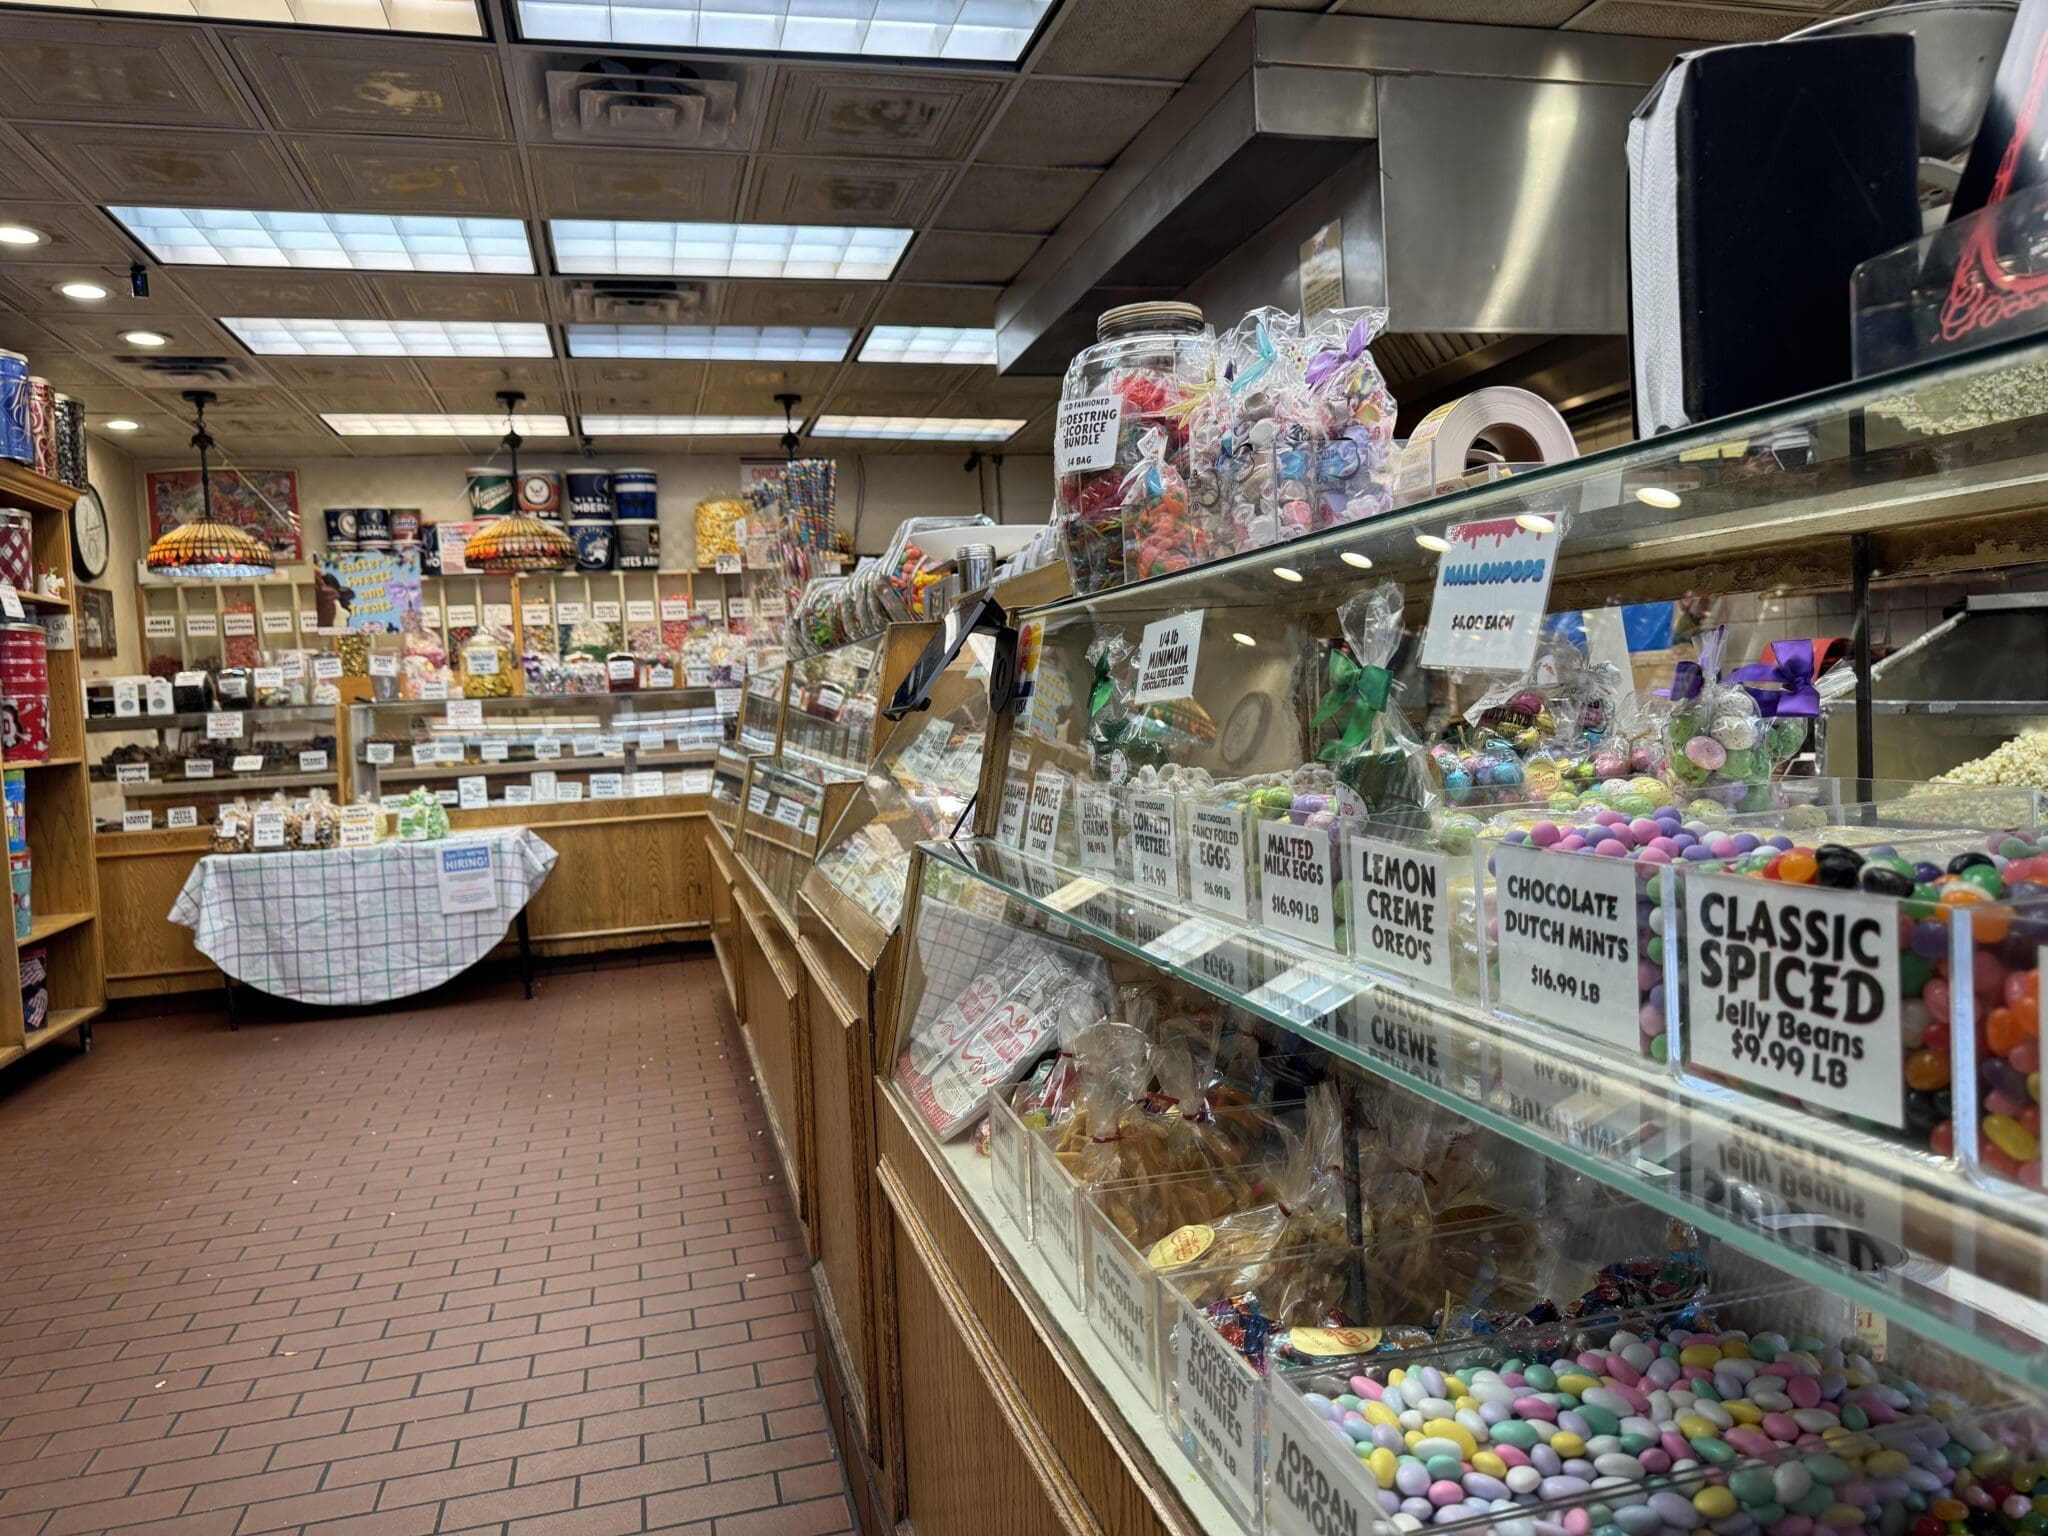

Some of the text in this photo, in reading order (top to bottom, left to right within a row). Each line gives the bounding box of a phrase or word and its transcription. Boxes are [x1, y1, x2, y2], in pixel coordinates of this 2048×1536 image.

[1074, 398, 1110, 410] FASHIONED
[1064, 434, 1101, 449] BUNDLE
[1076, 456, 1092, 466] BAG
[1443, 558, 1546, 587] MALLOWPOPS
[348, 599, 393, 616] Treats
[360, 585, 385, 600] and
[1485, 614, 1515, 630] EACH
[1148, 644, 1188, 671] MINIMUM
[1034, 785, 1060, 810] FUDGE
[1083, 802, 1104, 819] LUCKY
[1030, 811, 1054, 835] SLICES
[1082, 819, 1109, 837] CHARMS
[1133, 812, 1171, 837] CONFETTI
[1192, 823, 1239, 847] FANCY FOILED
[1207, 813, 1232, 826] CHOCOLATE
[1135, 833, 1171, 858] PRETZELS
[1199, 842, 1231, 872] EGGS
[1267, 834, 1314, 862] MALTED
[445, 857, 488, 871] HIRING!
[1264, 853, 1324, 886] MILK EGGS
[1362, 850, 1437, 898] LEMON
[1272, 893, 1320, 924] $16.99 LB
[1367, 888, 1435, 936] CREME
[1506, 875, 1619, 921] CHOCOLATE
[1504, 909, 1630, 964] DUTCH MINTS
[1699, 891, 1881, 968] CLASSIC
[1371, 925, 1432, 967] OREO'S
[1531, 964, 1601, 1005] $16.99 LB
[1698, 941, 1886, 1026] SPICED
[1715, 994, 1865, 1061] Jelly Beans
[1730, 1030, 1849, 1089] $9.99 LB
[1095, 1253, 1145, 1334] Coconut
[1098, 1290, 1144, 1373] Brittle
[1182, 1310, 1248, 1400] MILK CHOCOLATE
[1190, 1337, 1238, 1412] FOILED
[1187, 1359, 1243, 1449] BUNNIES
[1193, 1406, 1237, 1478] $16.99 LB
[1275, 1459, 1349, 1536] ALMON
[1280, 1431, 1358, 1536] JORDAN
